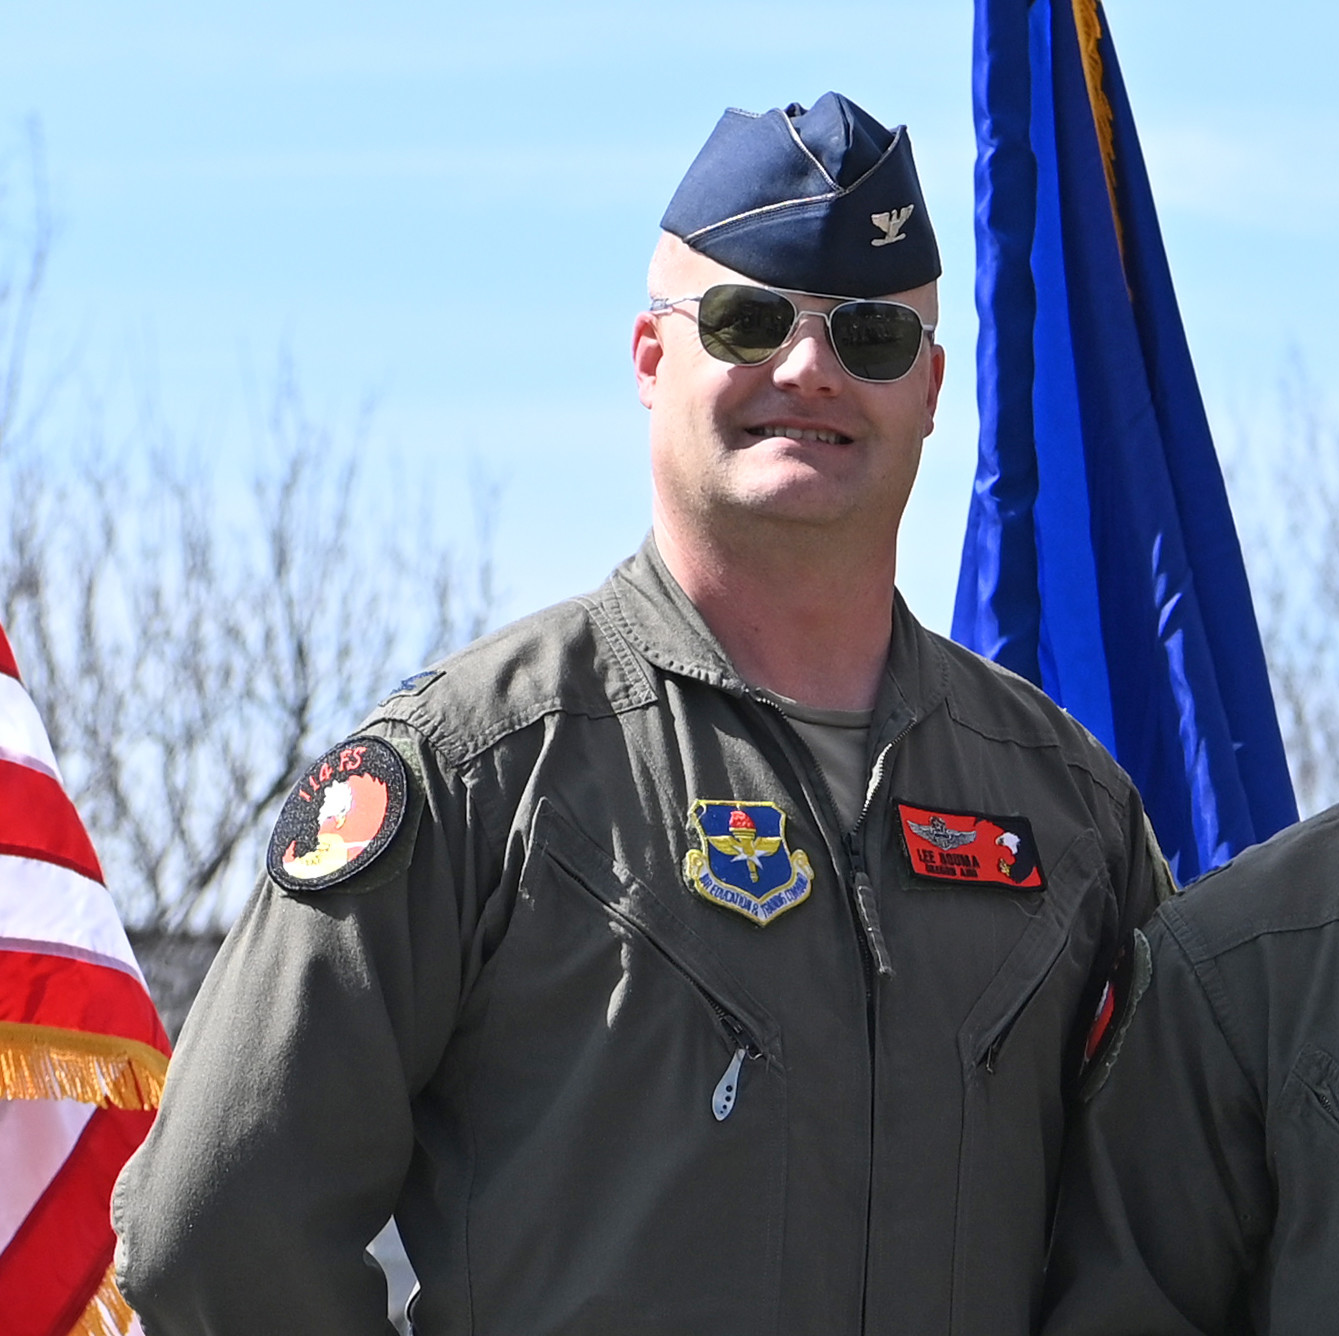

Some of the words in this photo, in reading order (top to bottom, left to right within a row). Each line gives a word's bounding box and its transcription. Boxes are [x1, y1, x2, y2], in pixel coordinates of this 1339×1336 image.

[299, 762, 334, 802] 114
[339, 747, 367, 771] FS
[917, 849, 937, 864] LEE
